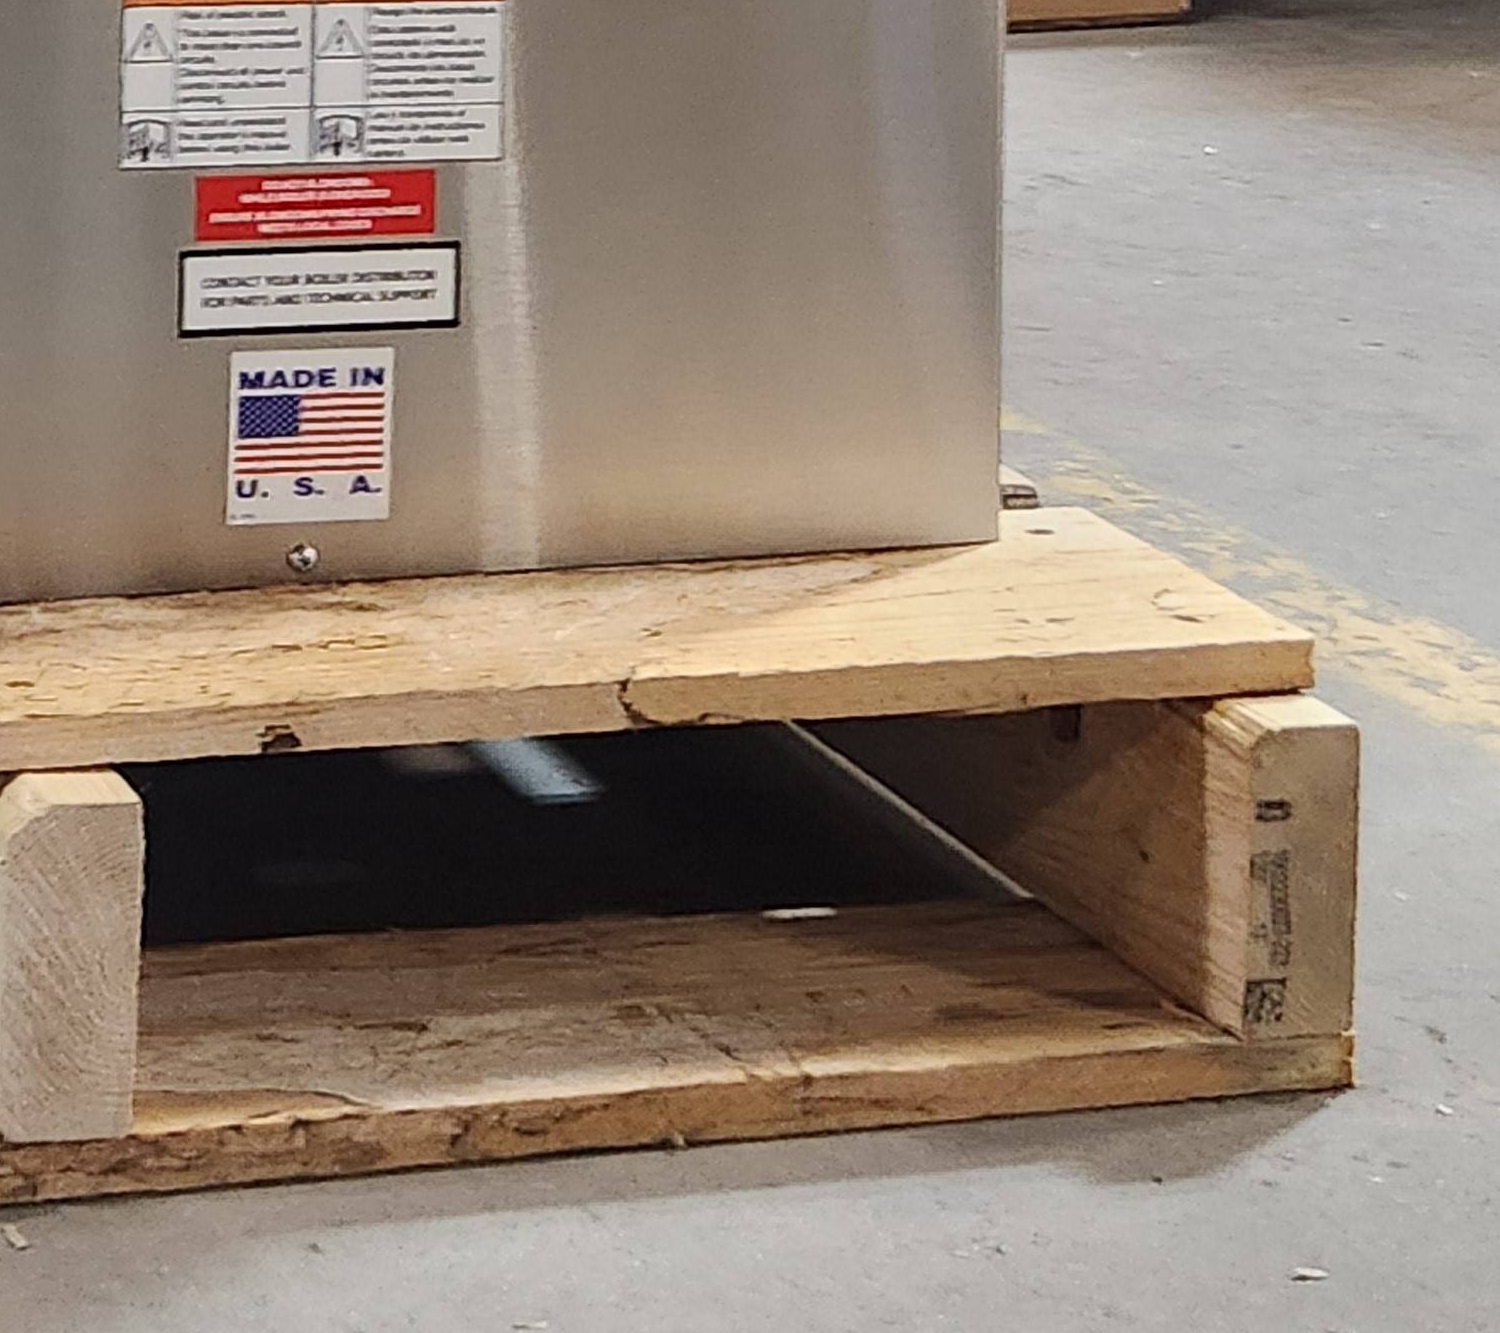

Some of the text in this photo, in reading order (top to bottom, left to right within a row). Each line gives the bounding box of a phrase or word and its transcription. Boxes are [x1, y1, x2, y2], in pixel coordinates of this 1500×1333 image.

[238, 366, 386, 390] MADE IN
[235, 475, 383, 500] U. S. A.
